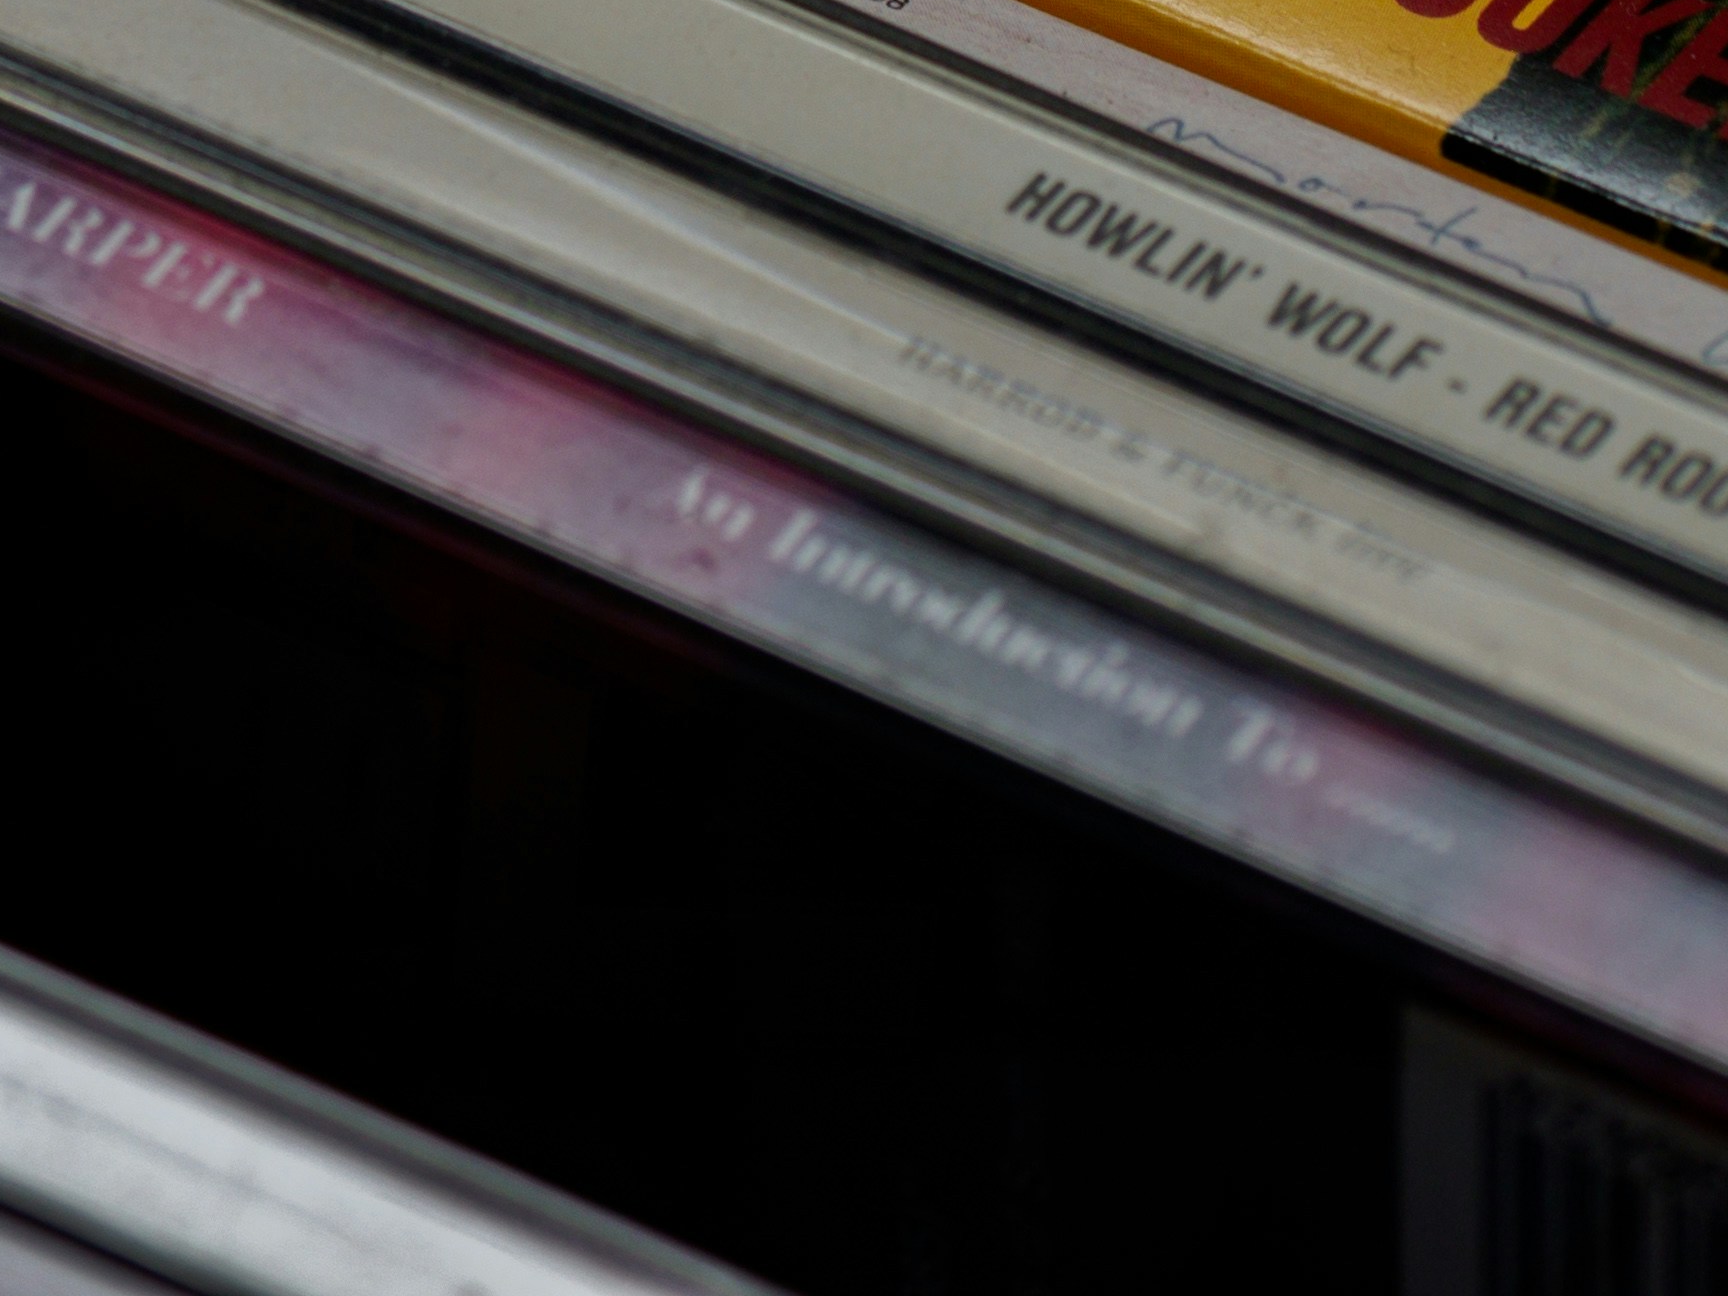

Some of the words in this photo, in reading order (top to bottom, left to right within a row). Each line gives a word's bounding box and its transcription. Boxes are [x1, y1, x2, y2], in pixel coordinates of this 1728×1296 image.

[1003, 170, 1265, 299] HOWLIN'
[1265, 283, 1448, 385] WOLF
[1481, 377, 1616, 459] RED
[765, 508, 1205, 739] Introduction
